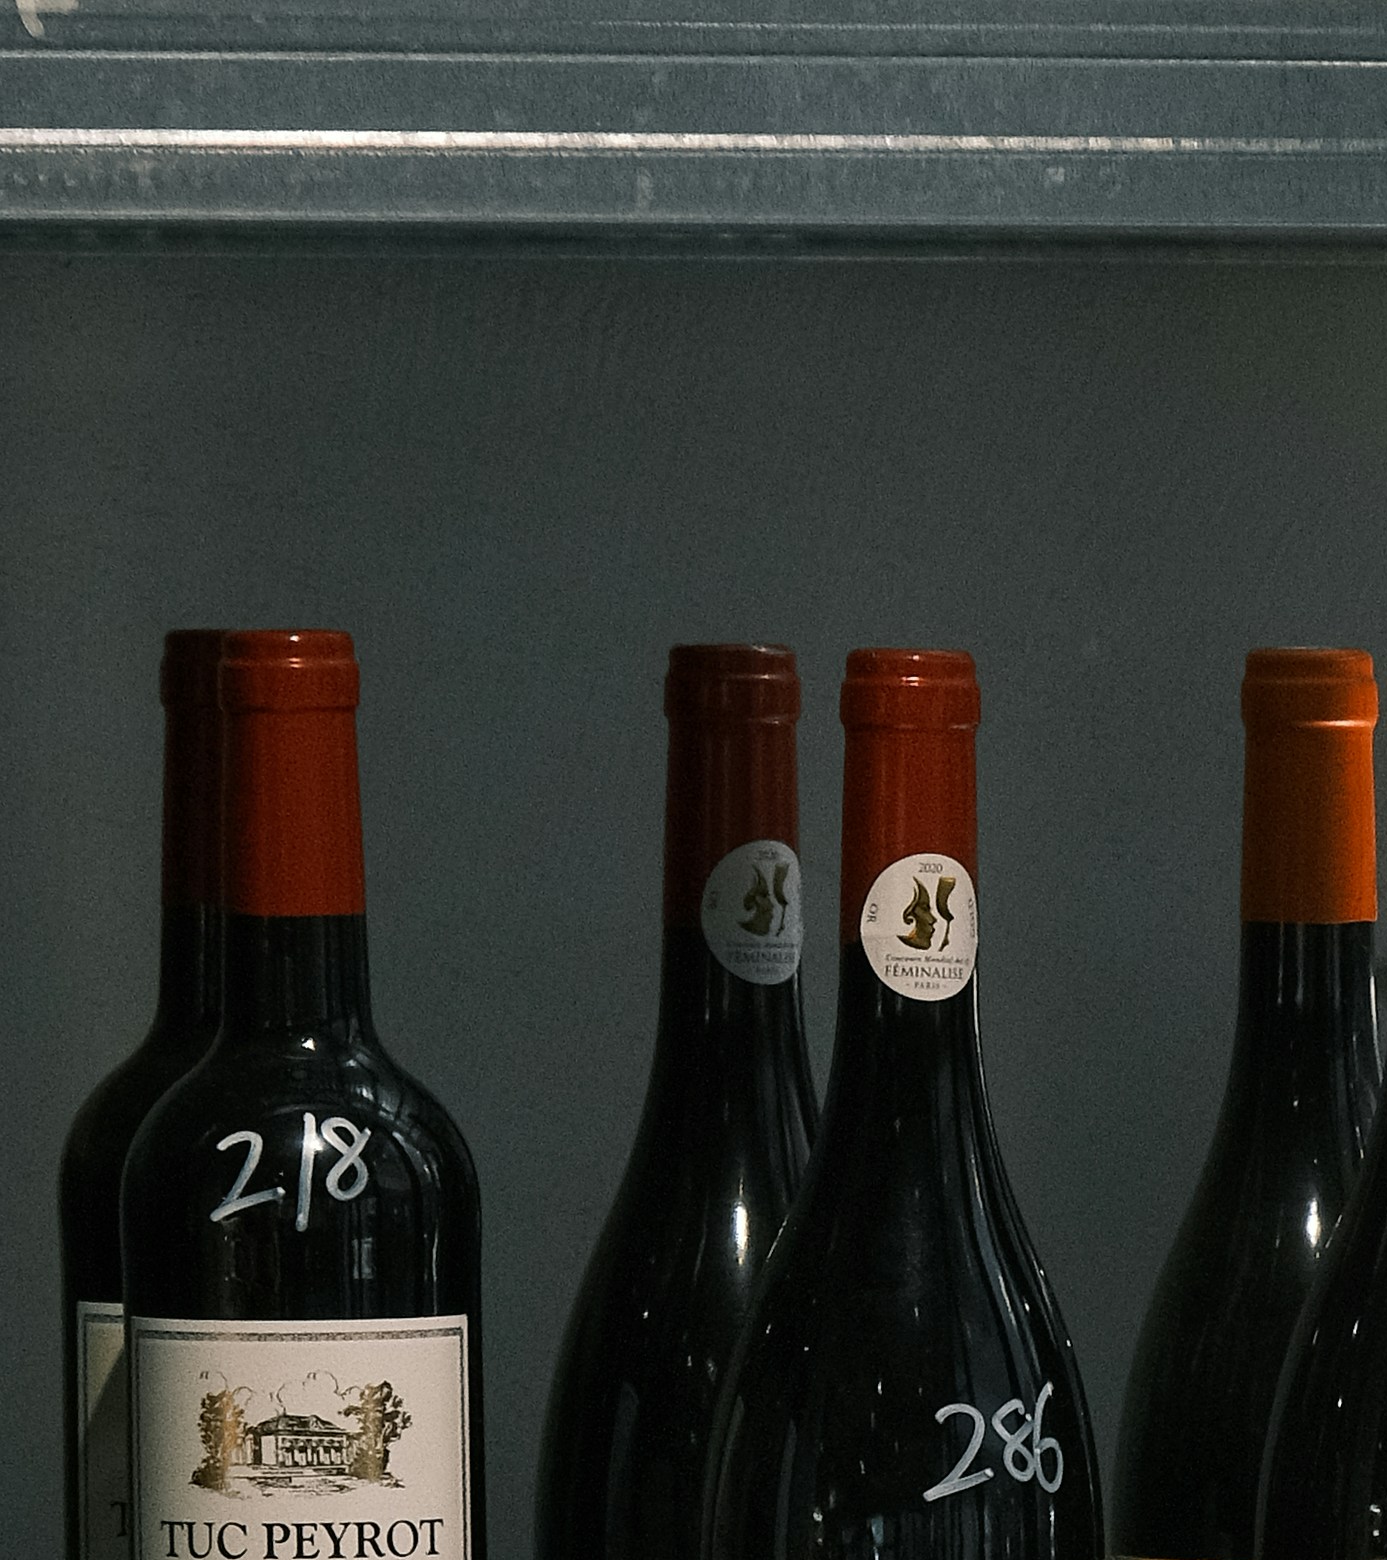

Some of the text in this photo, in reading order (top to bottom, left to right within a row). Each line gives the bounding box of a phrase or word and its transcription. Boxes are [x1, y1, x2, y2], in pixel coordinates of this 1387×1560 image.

[918, 862, 943, 874] 2020
[209, 1111, 372, 1232] 218
[922, 1380, 1064, 1502] 286
[160, 1518, 445, 1560] TUC PEYROT
